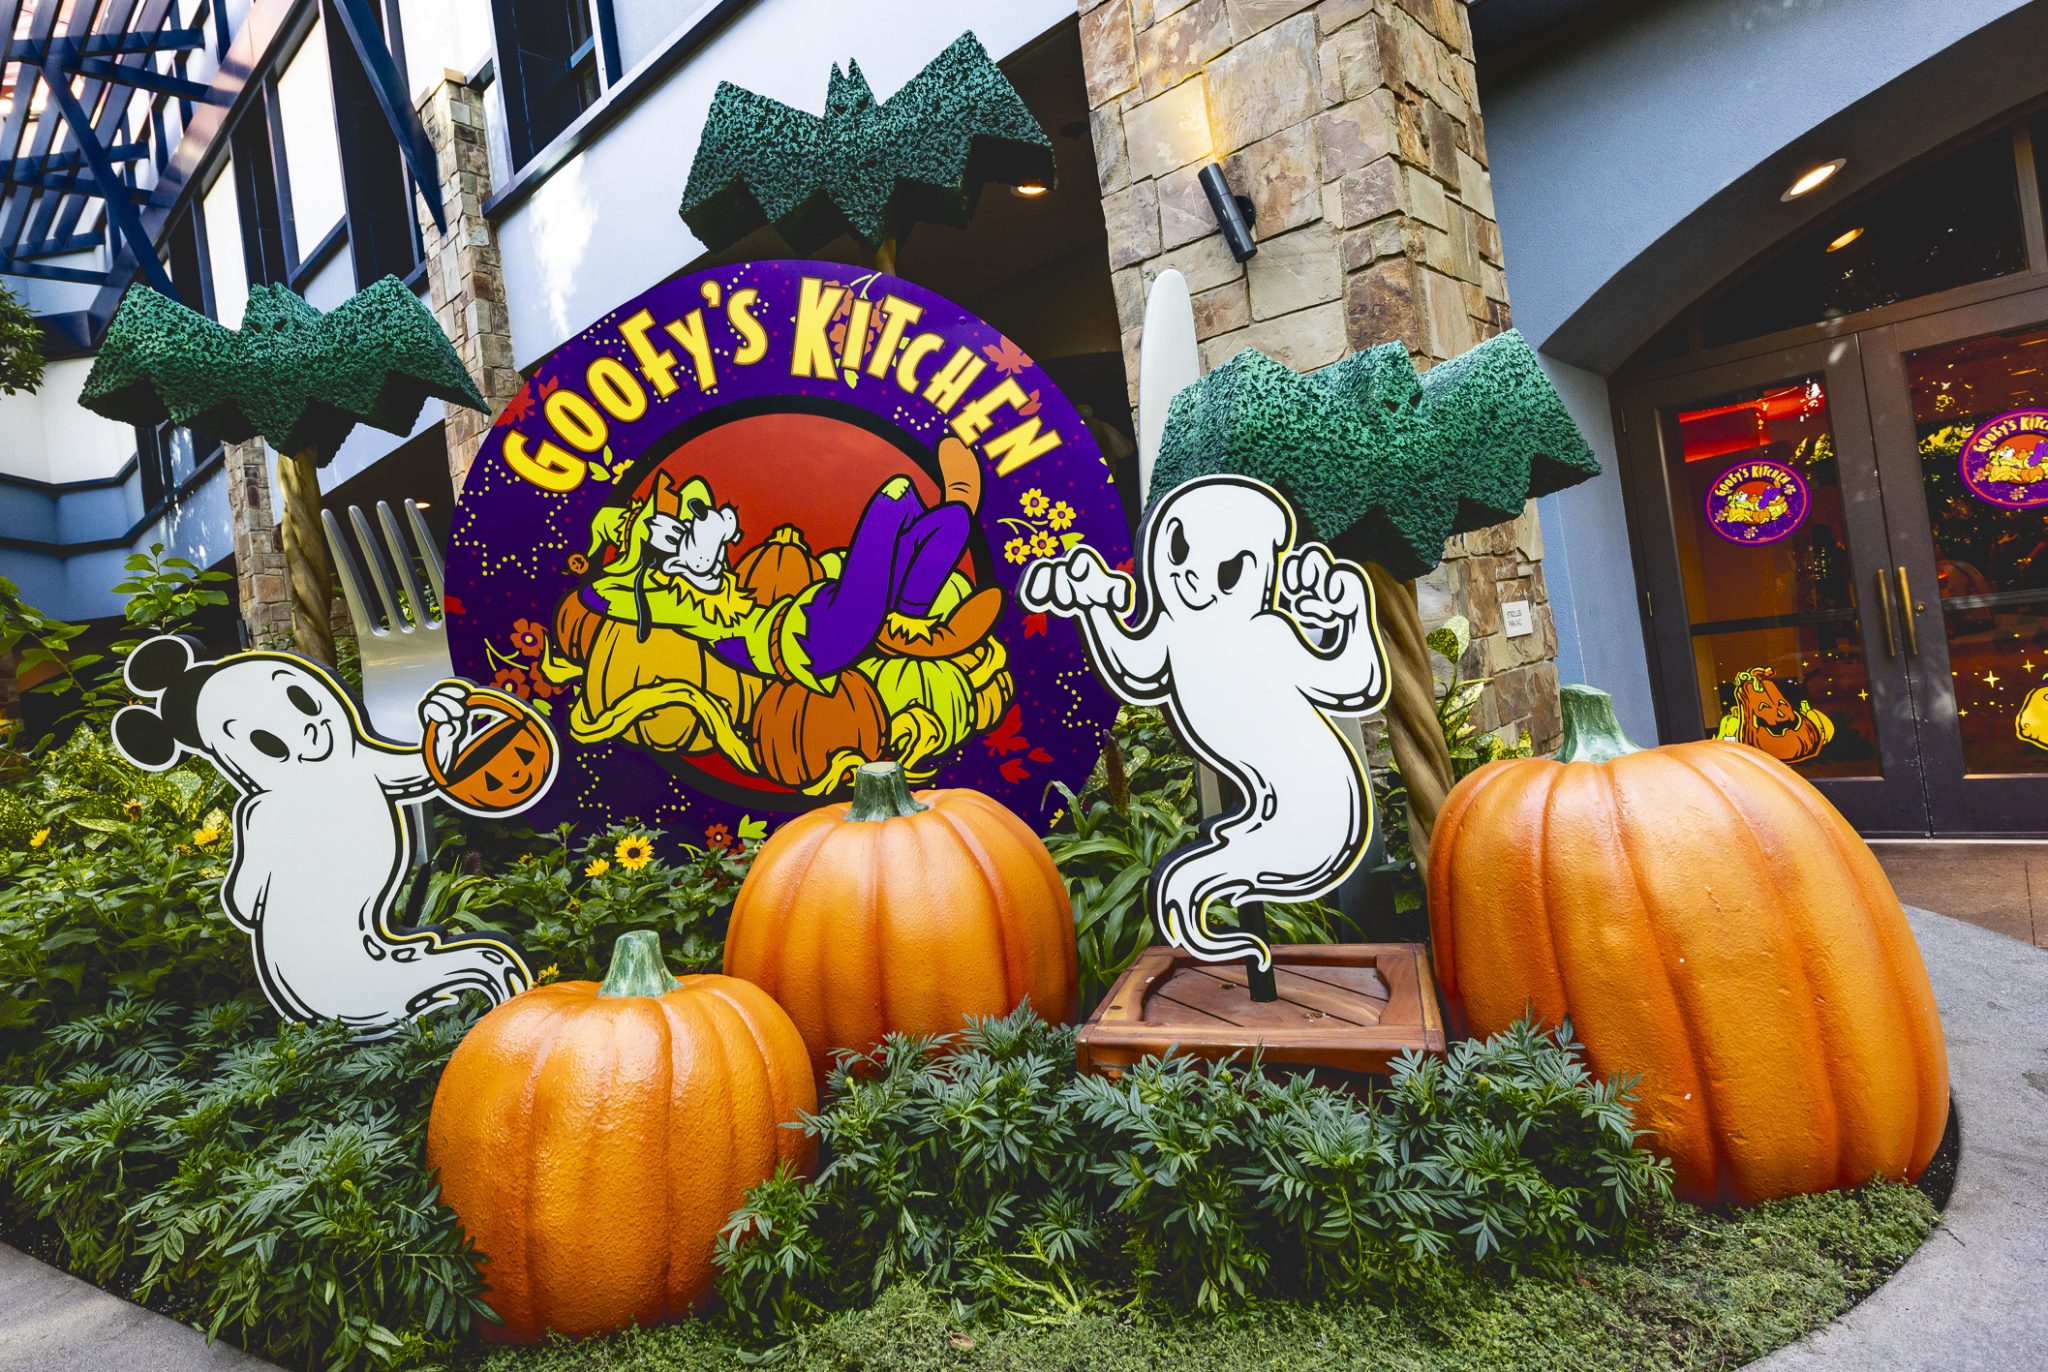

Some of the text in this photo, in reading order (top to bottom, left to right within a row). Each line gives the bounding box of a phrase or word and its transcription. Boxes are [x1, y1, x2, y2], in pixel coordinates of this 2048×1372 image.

[502, 276, 1063, 493] GOOFY'S KITCHEN
[1972, 419, 2018, 453] GOOFY'S
[1714, 465, 1792, 496] GOOFY'S KITCHEN
